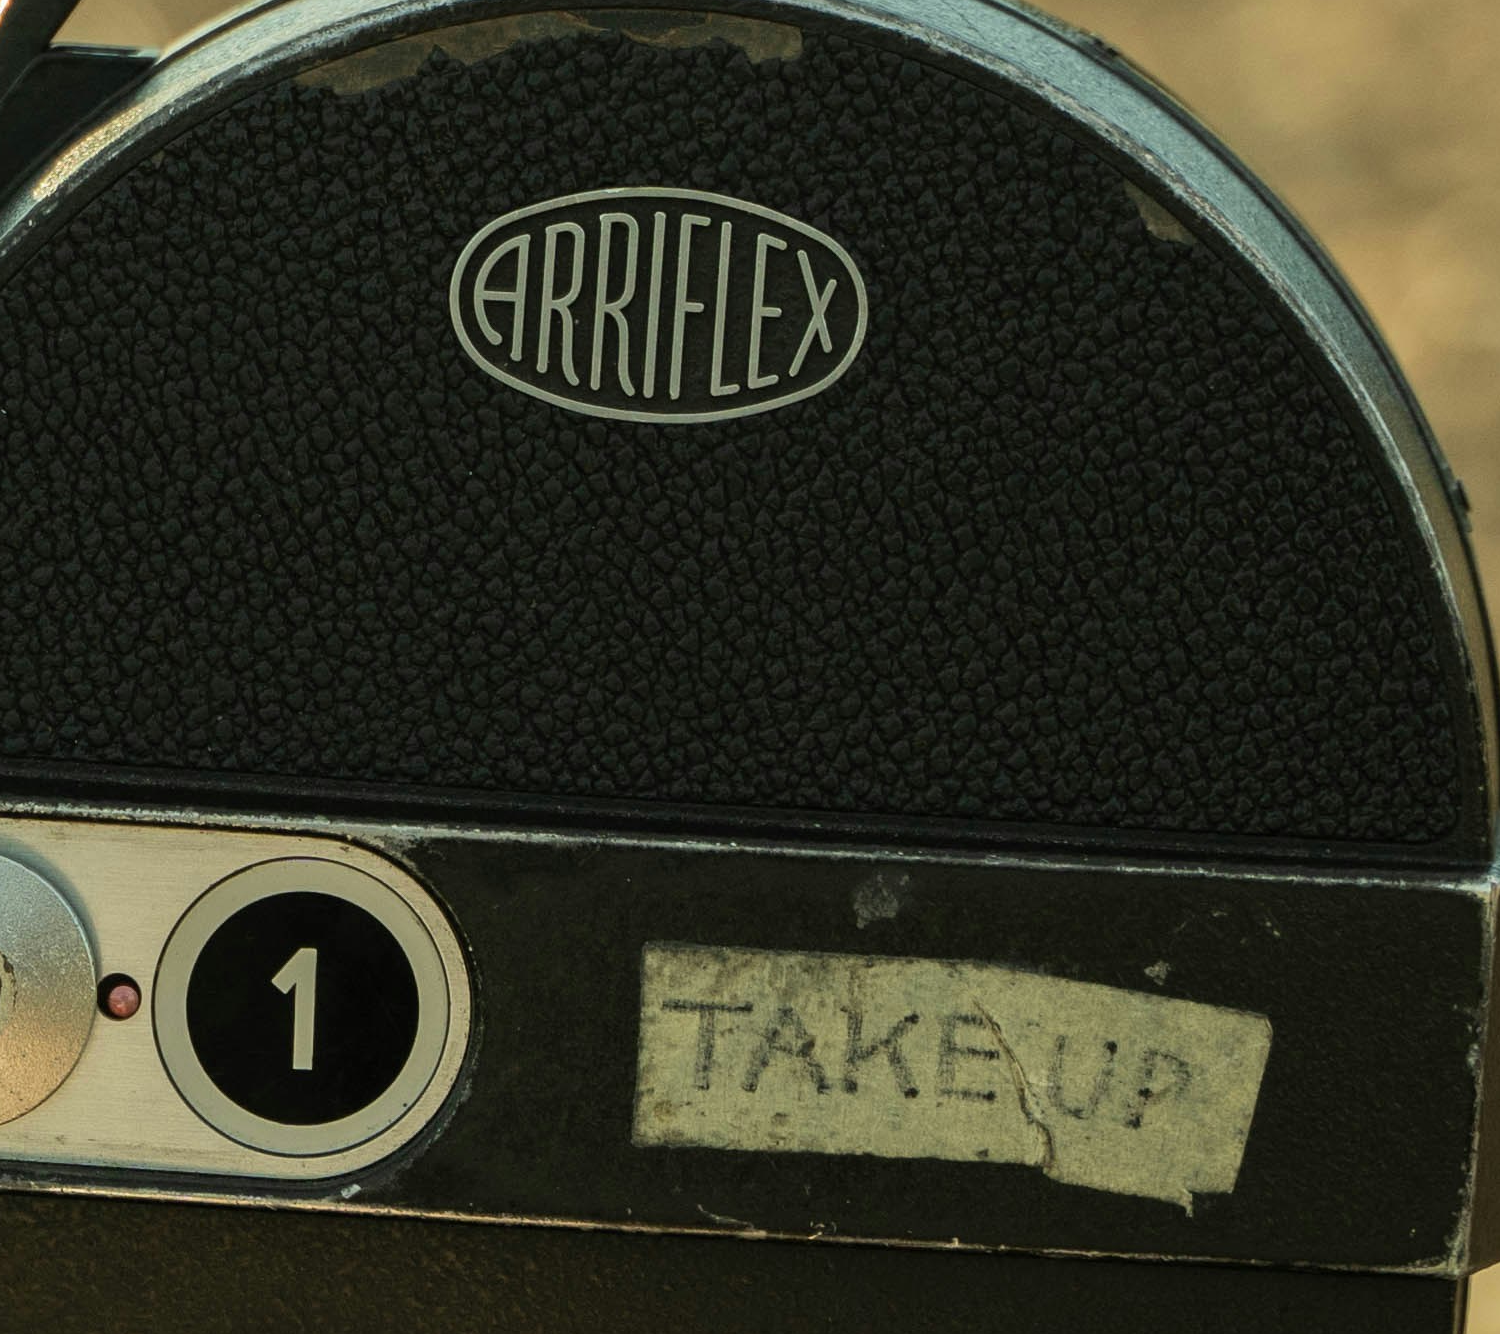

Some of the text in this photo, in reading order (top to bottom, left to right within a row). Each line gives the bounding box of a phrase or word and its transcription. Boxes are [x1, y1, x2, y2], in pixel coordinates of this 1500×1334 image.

[474, 212, 837, 400] ARRIFLEX
[271, 947, 318, 1071] 1
[662, 998, 1194, 1128] TAKE UP
